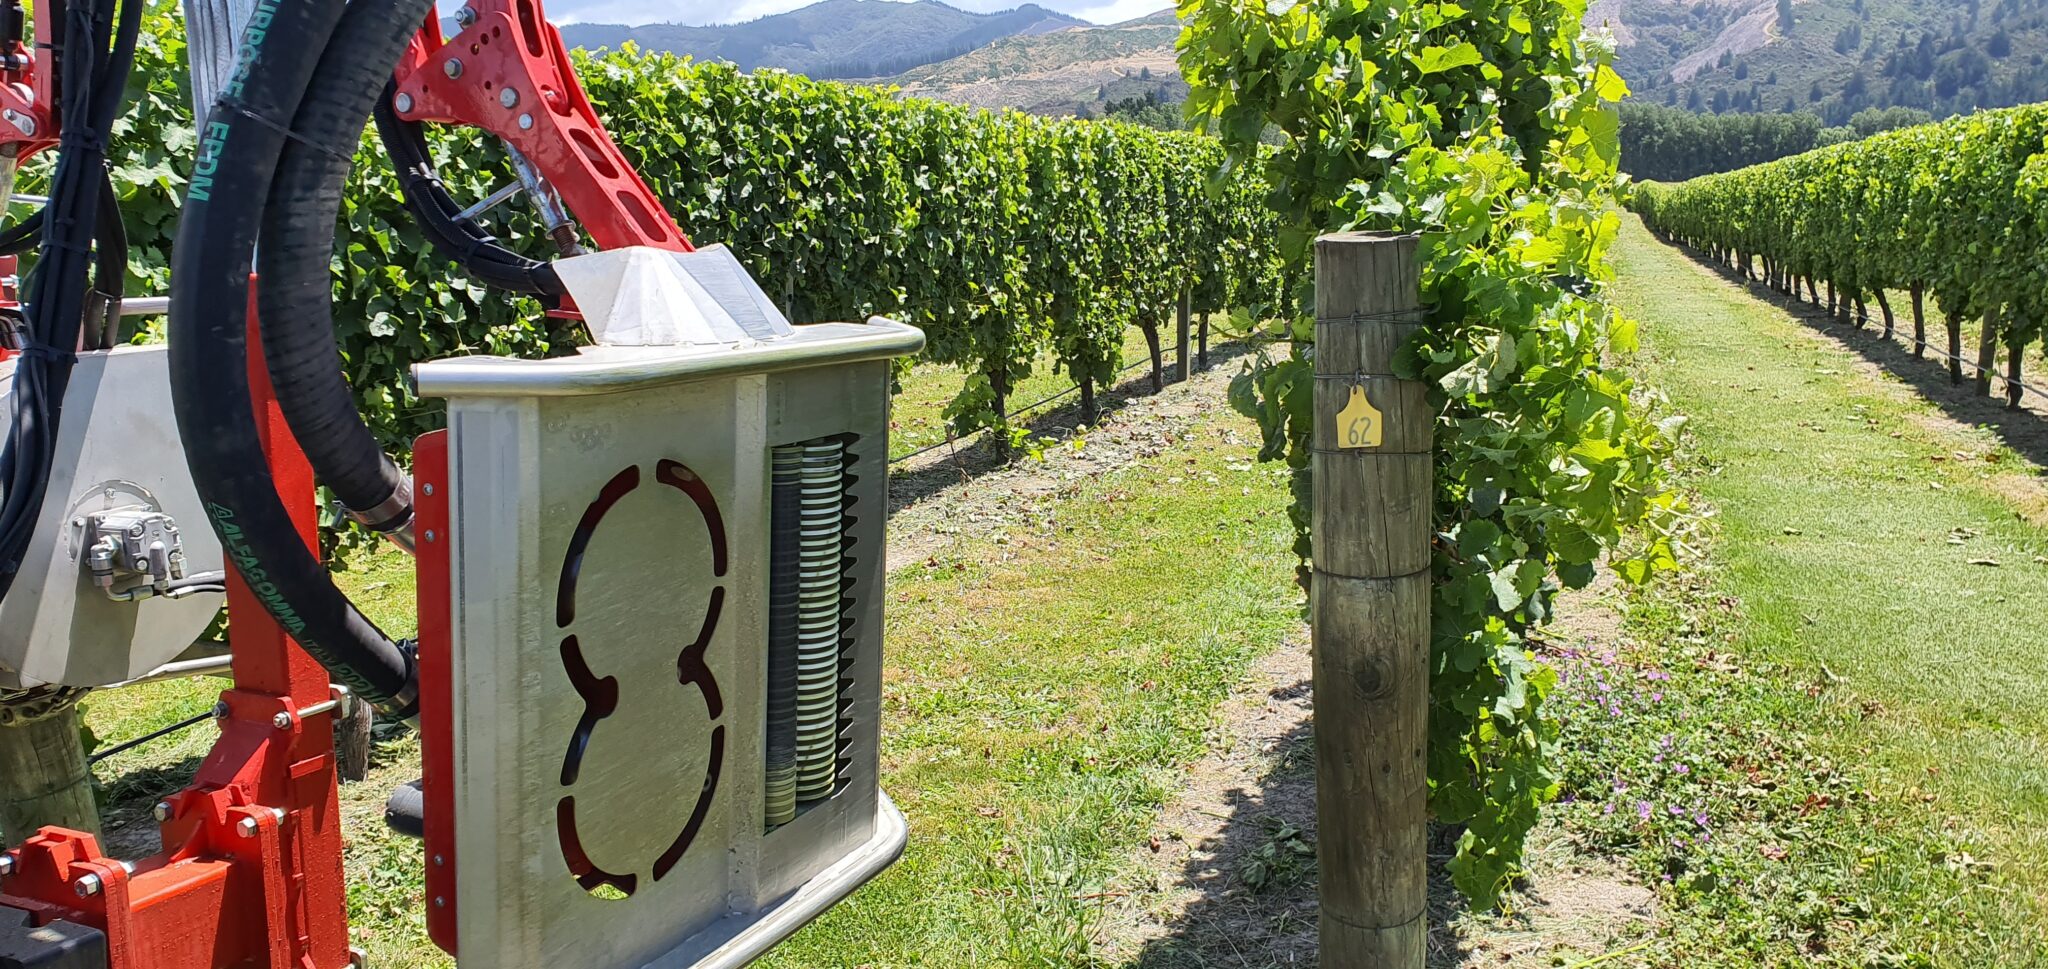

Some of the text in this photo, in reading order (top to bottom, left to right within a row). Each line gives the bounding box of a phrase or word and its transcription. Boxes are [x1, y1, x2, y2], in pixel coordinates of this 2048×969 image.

[187, 121, 231, 202] EPDM
[1348, 416, 1371, 445] 62
[217, 519, 307, 635] ALFAGOMMA
